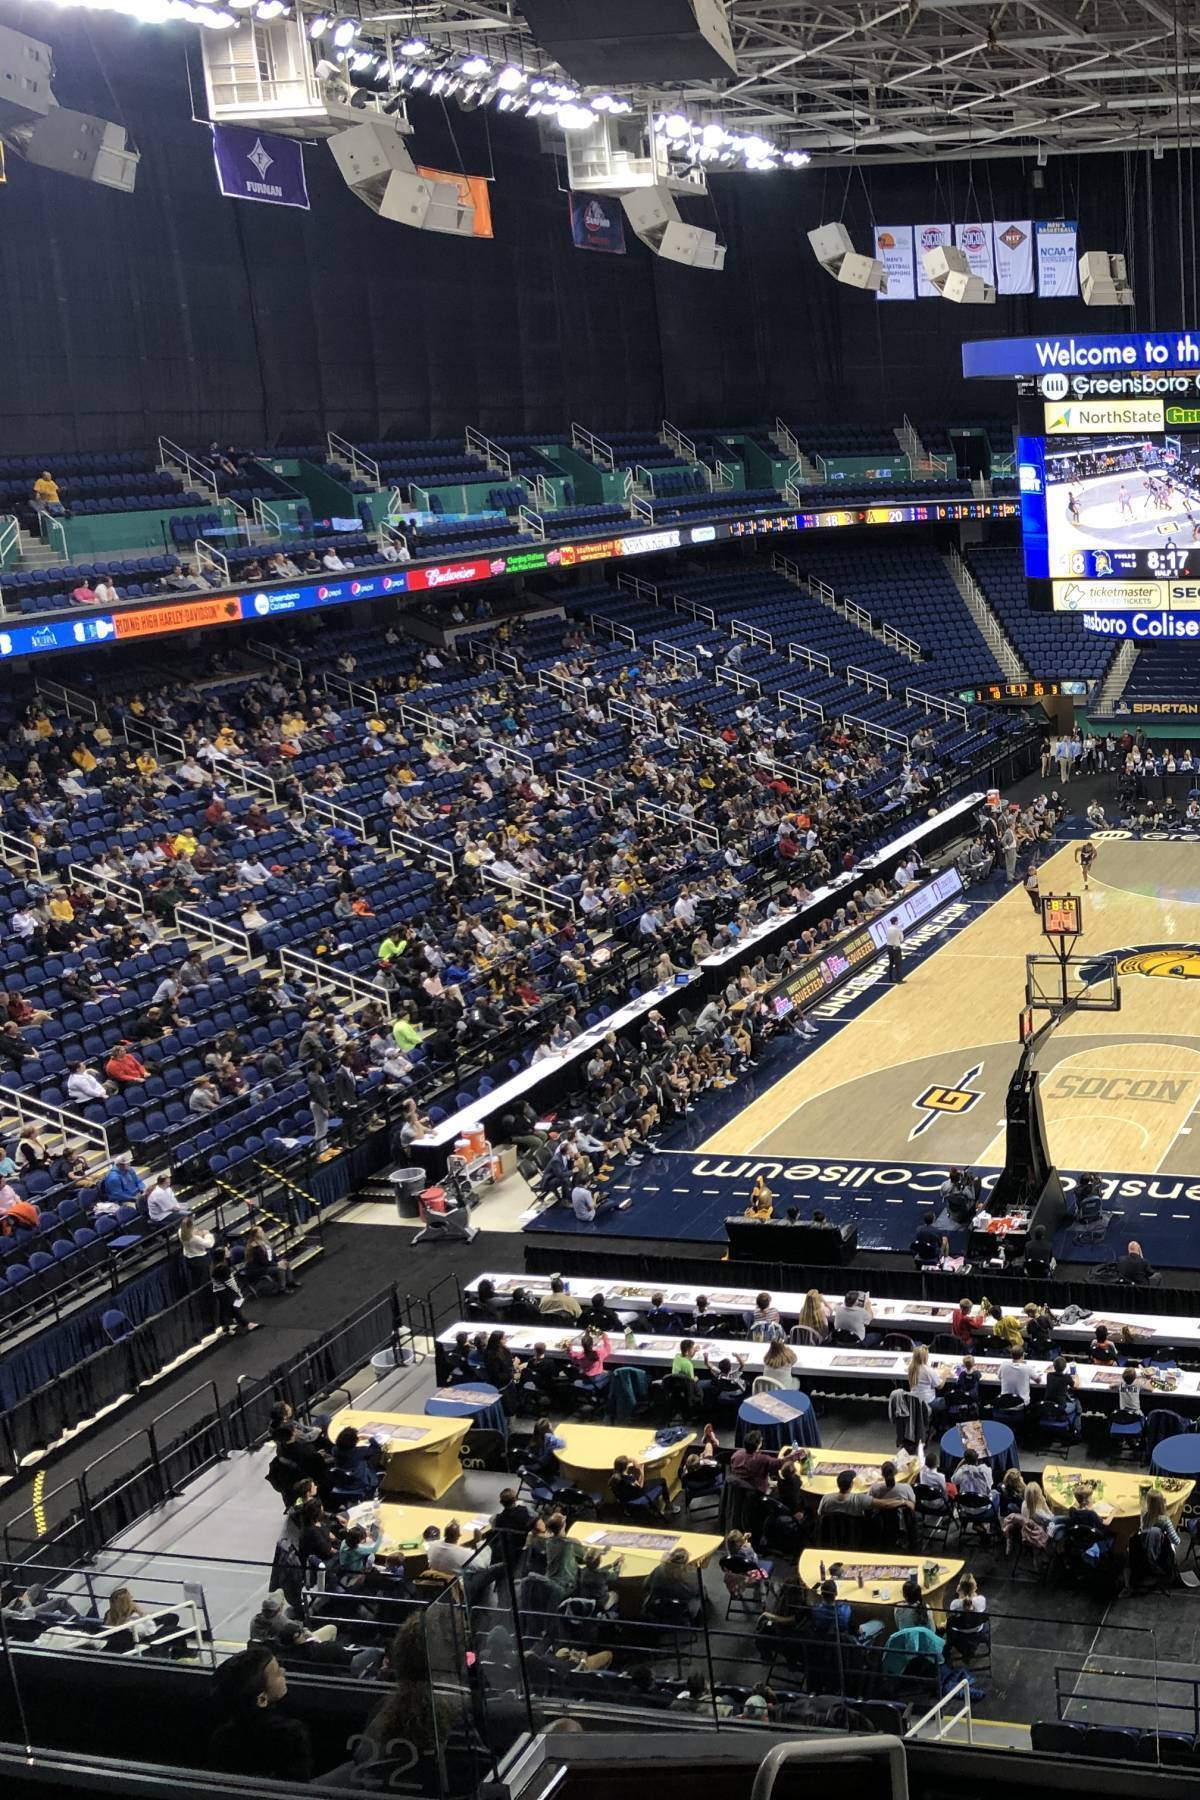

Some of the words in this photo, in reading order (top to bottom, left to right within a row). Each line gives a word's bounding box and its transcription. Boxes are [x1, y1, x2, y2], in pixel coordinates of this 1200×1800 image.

[1040, 247, 1067, 256] NCAA
[1035, 339, 1138, 367] Welcome
[1145, 340, 1170, 363] to
[1073, 373, 1188, 395] Greensboro
[1079, 409, 1162, 424] NorthState
[888, 511, 902, 522] 20
[1147, 550, 1189, 570] 8:17
[425, 566, 476, 586] Budweiser
[1089, 586, 1154, 598] ticketmaster
[116, 618, 140, 634] RIDING
[141, 616, 158, 630] HIGH
[159, 606, 219, 627] HARLEY-DAVIDSON
[1133, 703, 1198, 714] SPARTAN
[791, 977, 823, 1006] SQUEEZED
[1047, 1075, 1192, 1104] SOCON
